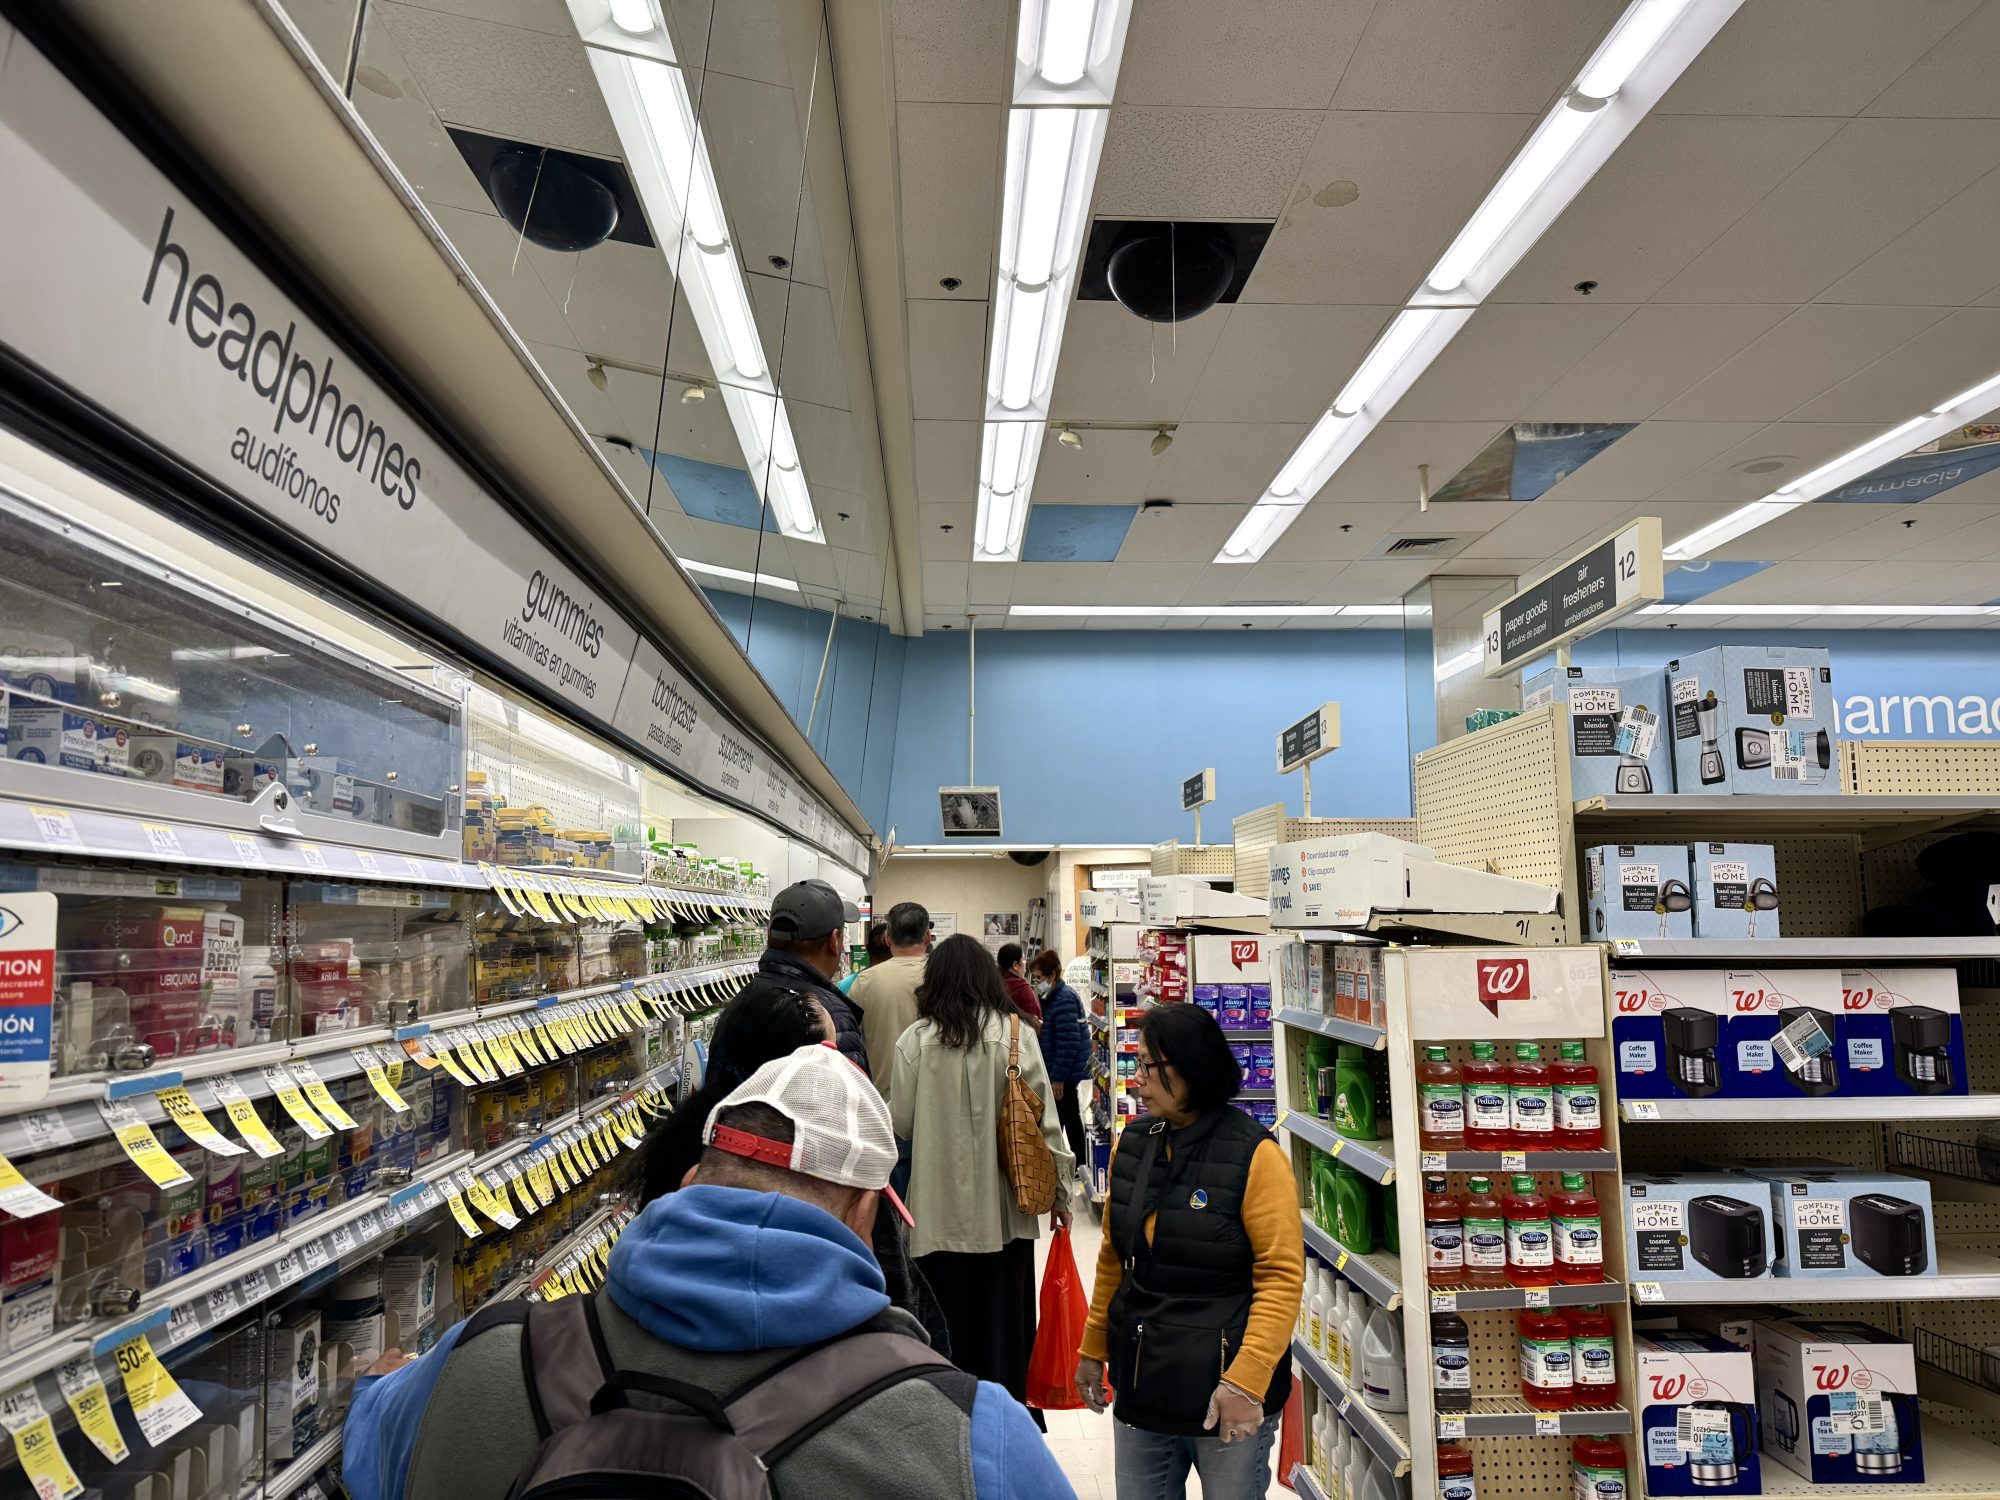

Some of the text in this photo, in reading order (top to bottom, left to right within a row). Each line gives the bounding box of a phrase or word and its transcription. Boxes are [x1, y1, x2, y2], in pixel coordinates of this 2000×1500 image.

[142, 206, 421, 511] headphones
[230, 426, 340, 525] audífonos
[1618, 550, 1636, 581] 12
[1577, 564, 1589, 582] air
[1562, 576, 1605, 609] fresheners
[522, 569, 604, 659] gummies
[1505, 599, 1548, 636] paper goods
[1564, 599, 1604, 627] ambientadores
[1526, 627, 1533, 636] de
[1534, 622, 1547, 639] papel
[1487, 630, 1499, 654] 13
[502, 616, 597, 699] vitaminas en gummies
[1673, 680, 1697, 692] COMPLETE
[1573, 690, 1615, 699] COMPLETE
[1673, 691, 1697, 701] HOME
[1788, 671, 1800, 714] HOME
[1799, 671, 1809, 714] COMPLETE
[651, 669, 697, 733] toothpaste
[1574, 702, 1616, 711] HOME
[64, 733, 95, 750] Prevagen
[1307, 850, 1329, 860] Download
[1338, 849, 1349, 859] app
[1622, 865, 1656, 873] COMPLETE
[1713, 863, 1745, 871] COMPLETE
[1624, 875, 1657, 883] HOME
[1714, 872, 1746, 880] HOME
[164, 926, 193, 946] Qunol
[160, 973, 199, 988] UBIQUINOL
[1224, 999, 1244, 1007] always
[1432, 1103, 1461, 1111] Pedialyte
[1477, 1098, 1504, 1106] Pedialyte
[1518, 1100, 1546, 1109] Pedialyte
[1571, 1098, 1597, 1106] Pedialyte
[128, 1138, 155, 1153] FREE
[213, 1185, 233, 1198] AREDS
[1636, 1204, 1678, 1213] COMPLETE
[1798, 1203, 1840, 1211] COMPLETE
[1638, 1217, 1679, 1226] HOME
[1799, 1215, 1840, 1225] HOME
[1521, 1234, 1549, 1243] Pedialyte
[1572, 1232, 1598, 1241] Pedialyte
[1584, 1351, 1611, 1360] Pedialyte
[1857, 1400, 1865, 1409] 10
[1694, 1433, 1702, 1443] 10
[1597, 1484, 1623, 1493] Pedialyte
[1446, 1490, 1472, 1499] Pedialyte
